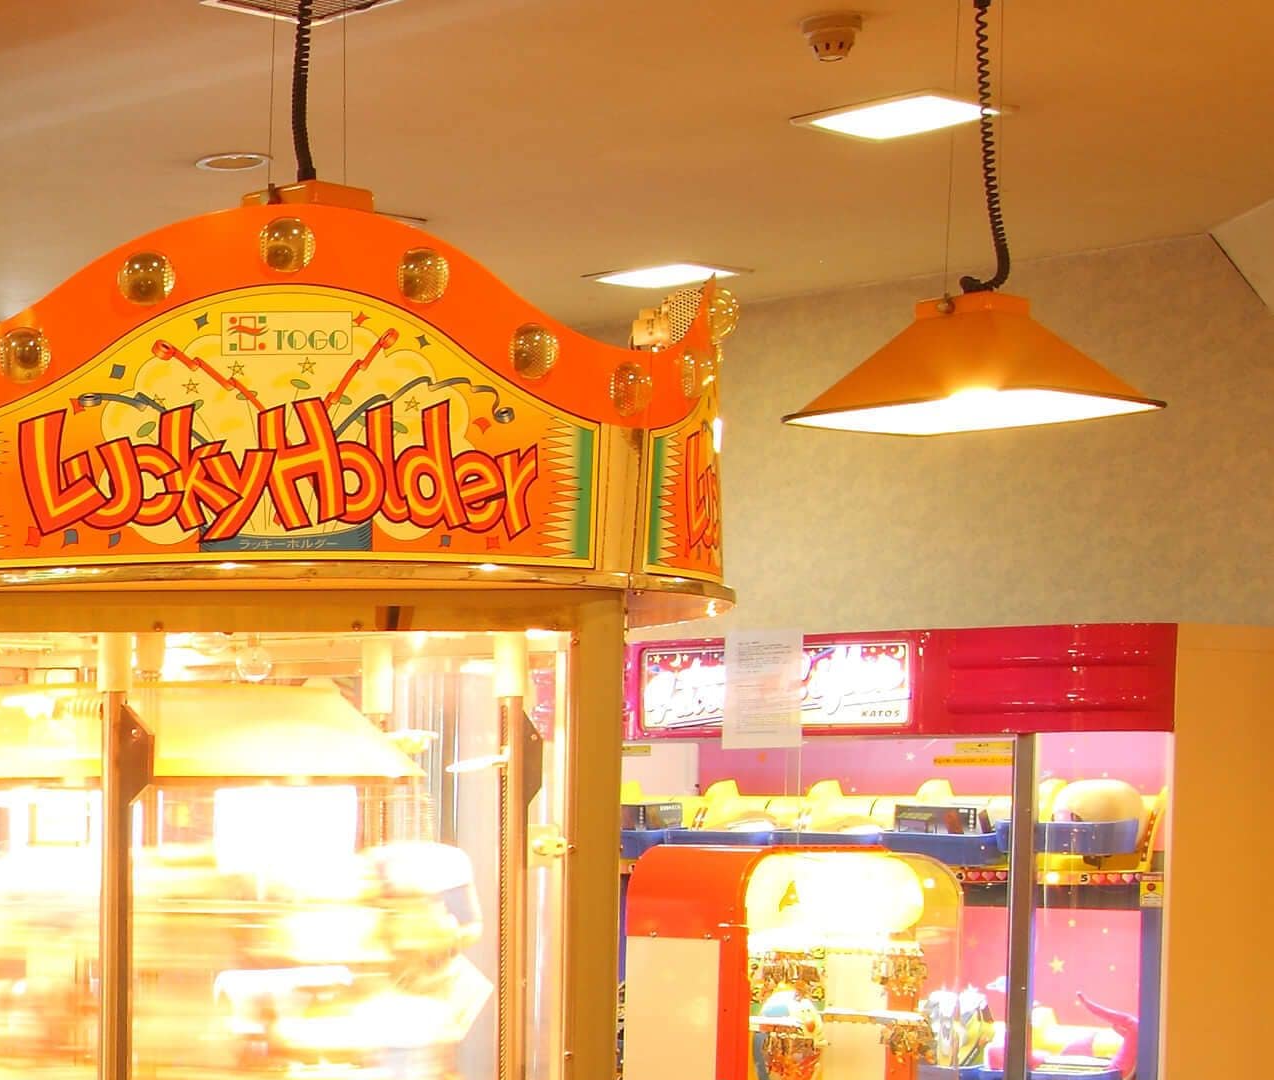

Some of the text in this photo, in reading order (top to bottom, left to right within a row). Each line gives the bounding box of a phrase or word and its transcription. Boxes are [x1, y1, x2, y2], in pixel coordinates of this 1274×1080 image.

[272, 329, 349, 352] TOGO
[18, 396, 538, 542] Lucky Holder
[239, 539, 339, 551] ラッキーホルダー
